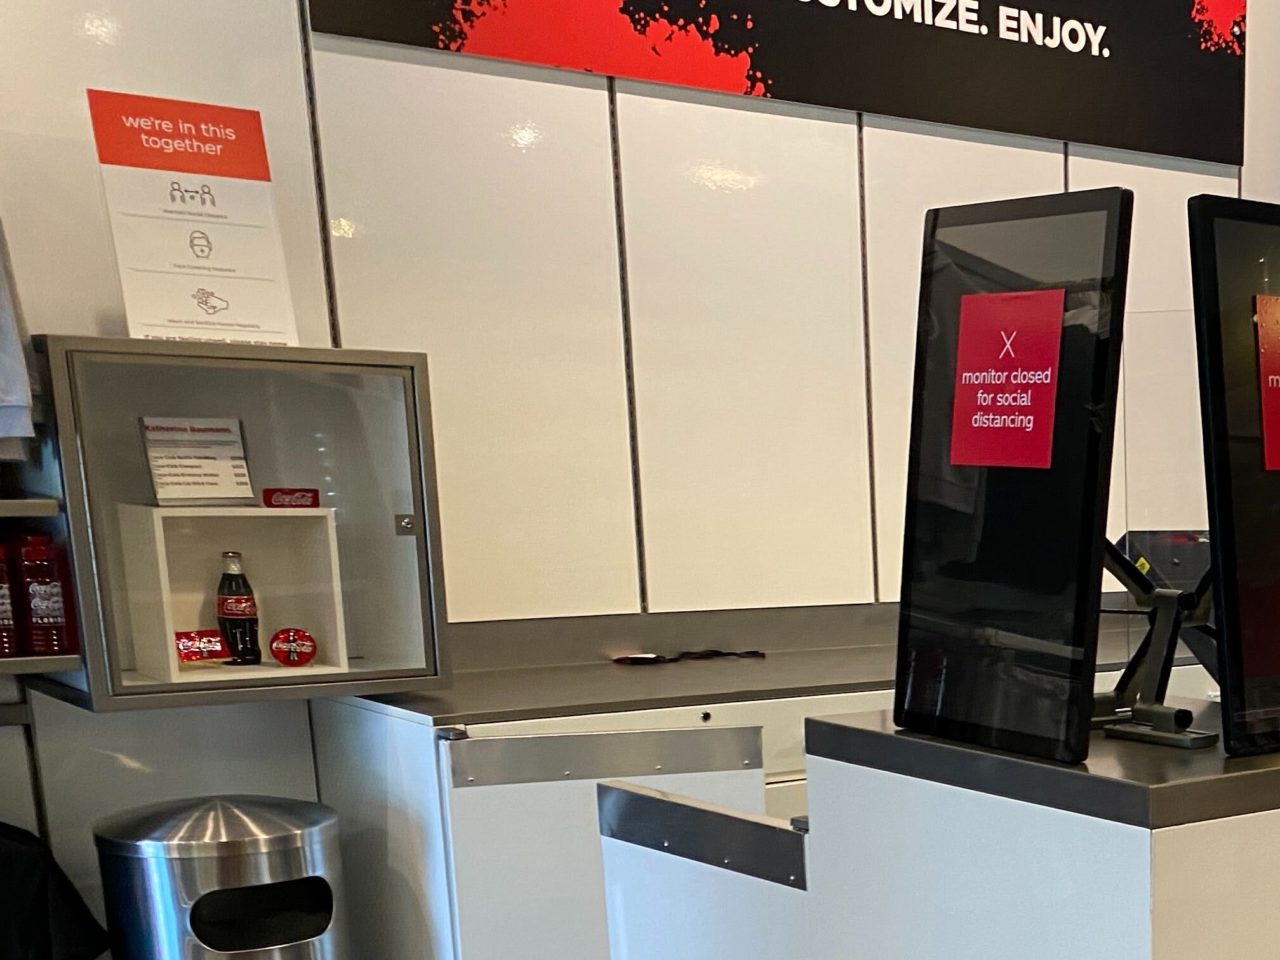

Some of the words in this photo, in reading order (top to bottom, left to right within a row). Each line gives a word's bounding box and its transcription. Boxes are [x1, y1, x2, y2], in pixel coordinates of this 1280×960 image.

[999, 5, 1110, 58] ENJOY.
[121, 115, 173, 132] we're
[179, 119, 196, 135] in
[200, 123, 236, 140] this
[141, 133, 223, 156] together
[962, 369, 1008, 384] monitor
[1011, 367, 1051, 384] closed
[977, 390, 994, 406] for
[996, 390, 1031, 406] social
[972, 412, 1034, 431] distancing
